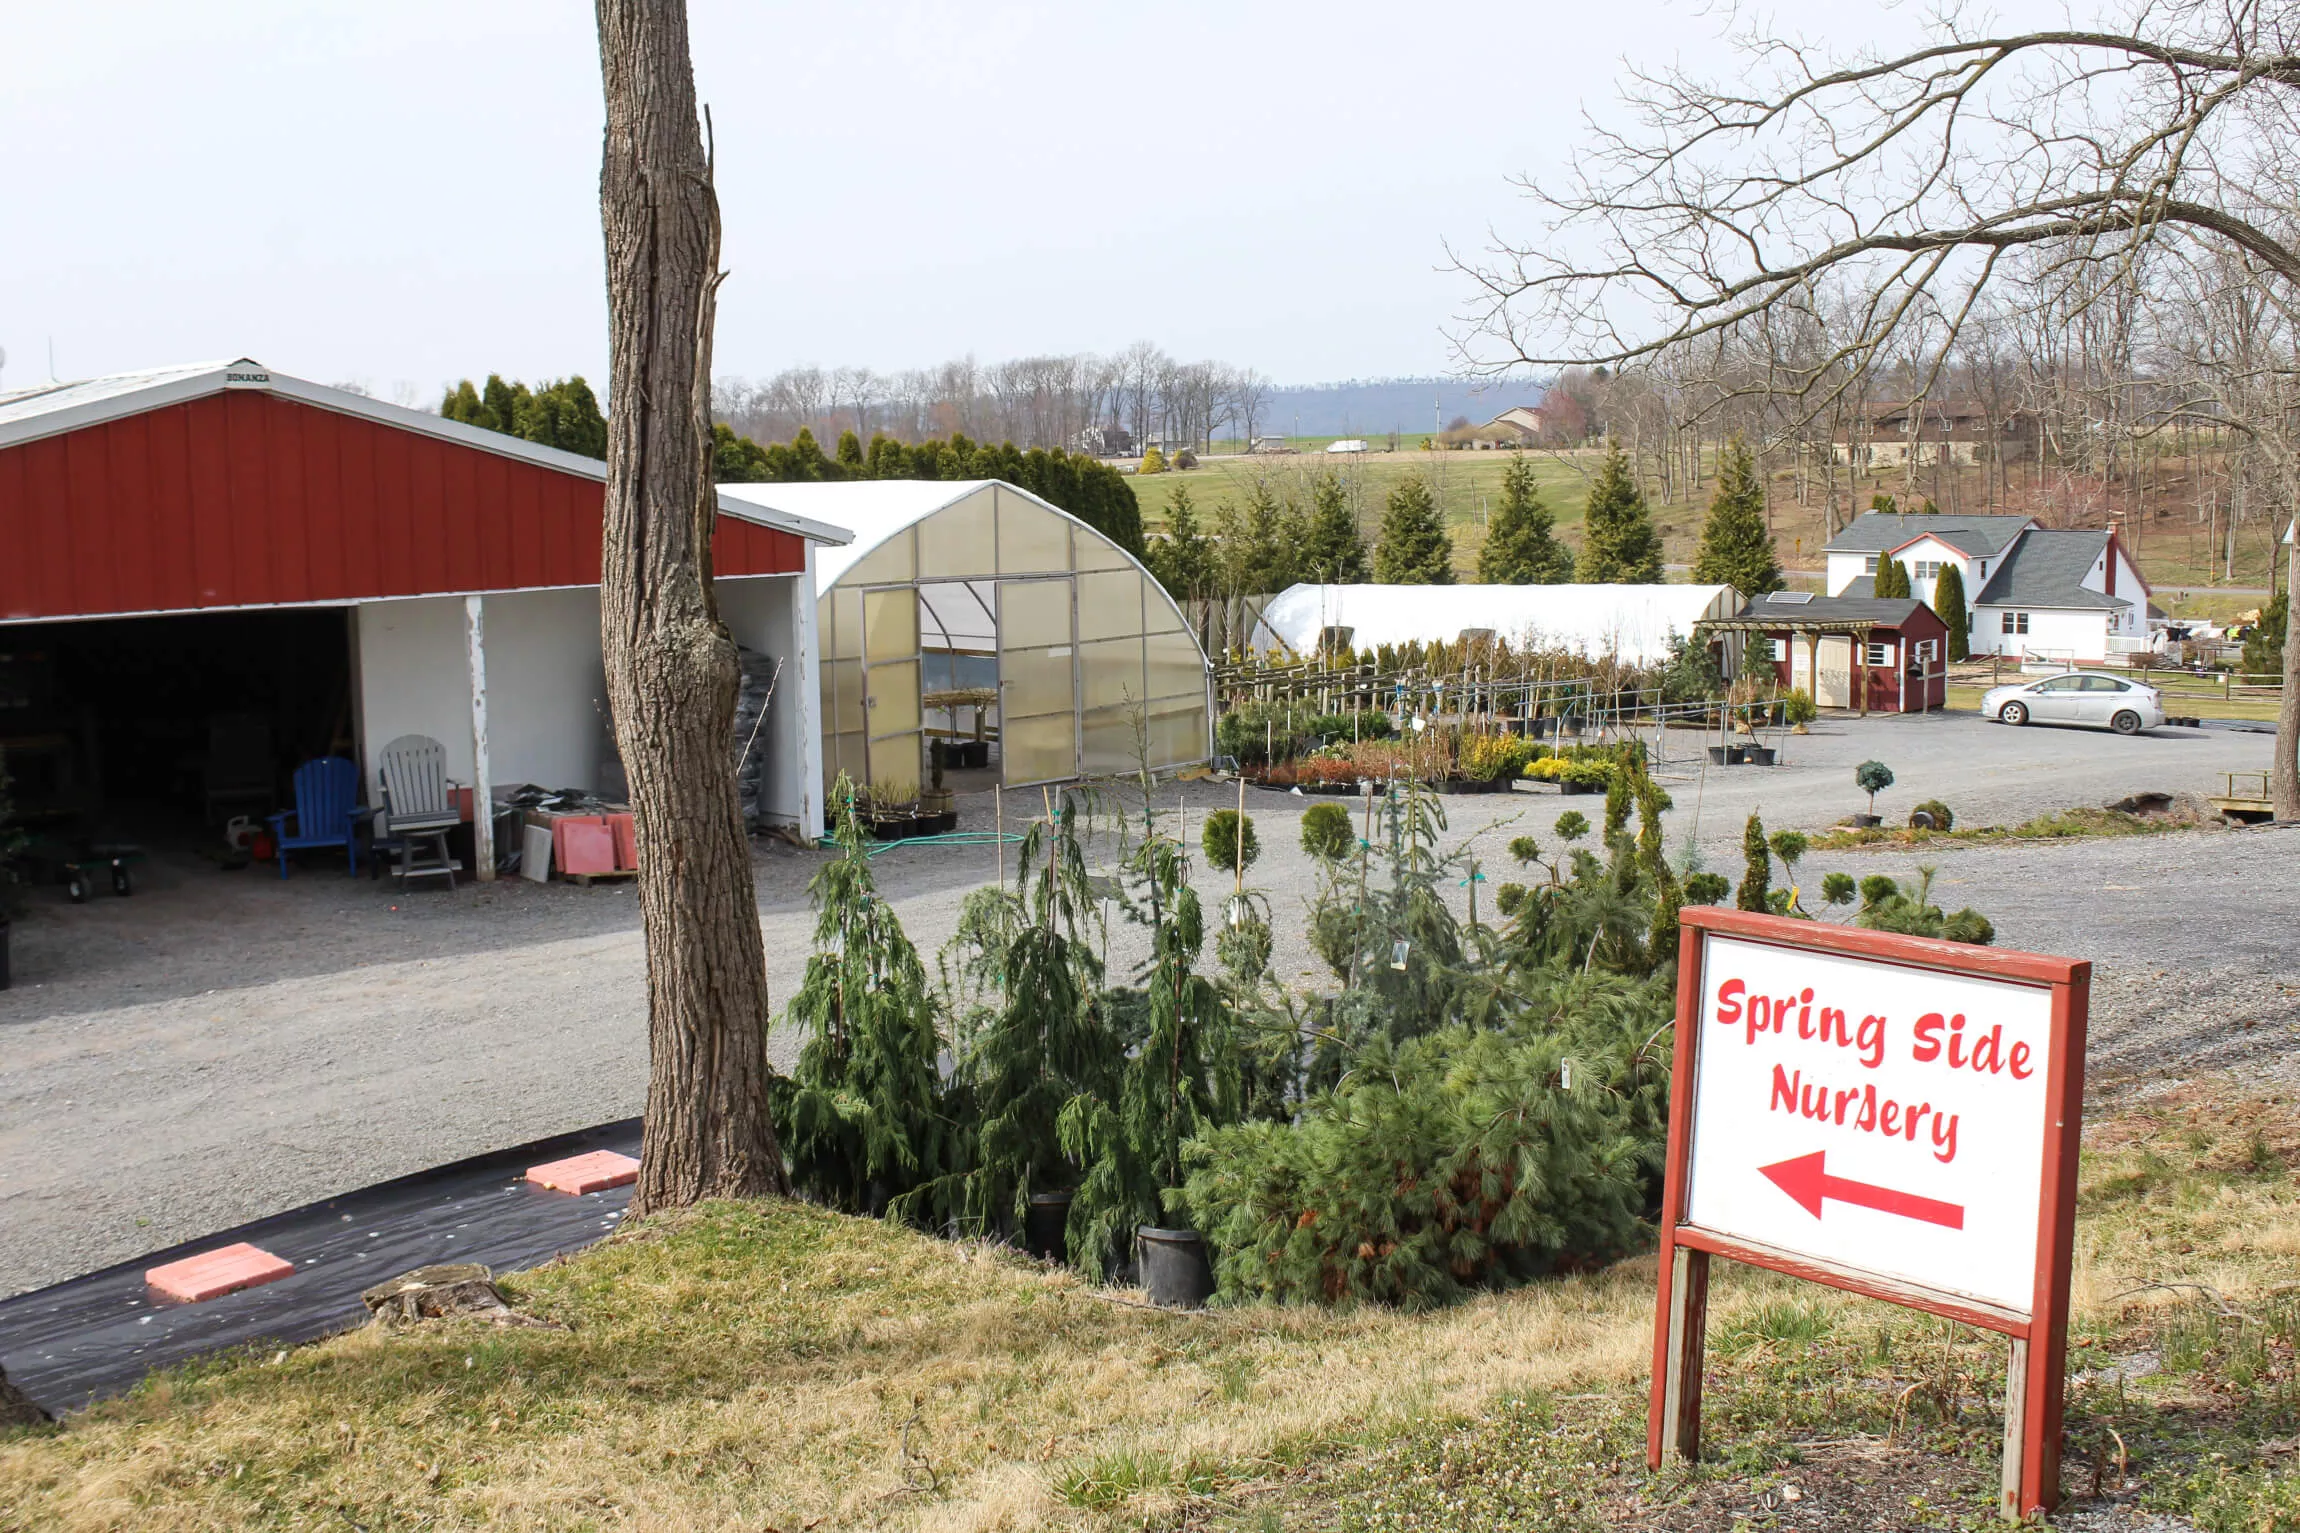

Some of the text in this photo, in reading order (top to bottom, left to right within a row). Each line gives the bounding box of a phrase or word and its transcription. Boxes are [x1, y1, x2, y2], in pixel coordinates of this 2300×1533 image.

[226, 373, 270, 382] BONANZA
[1717, 978, 2034, 1080] Spring Side
[1771, 1063, 1959, 1164] Nursery
